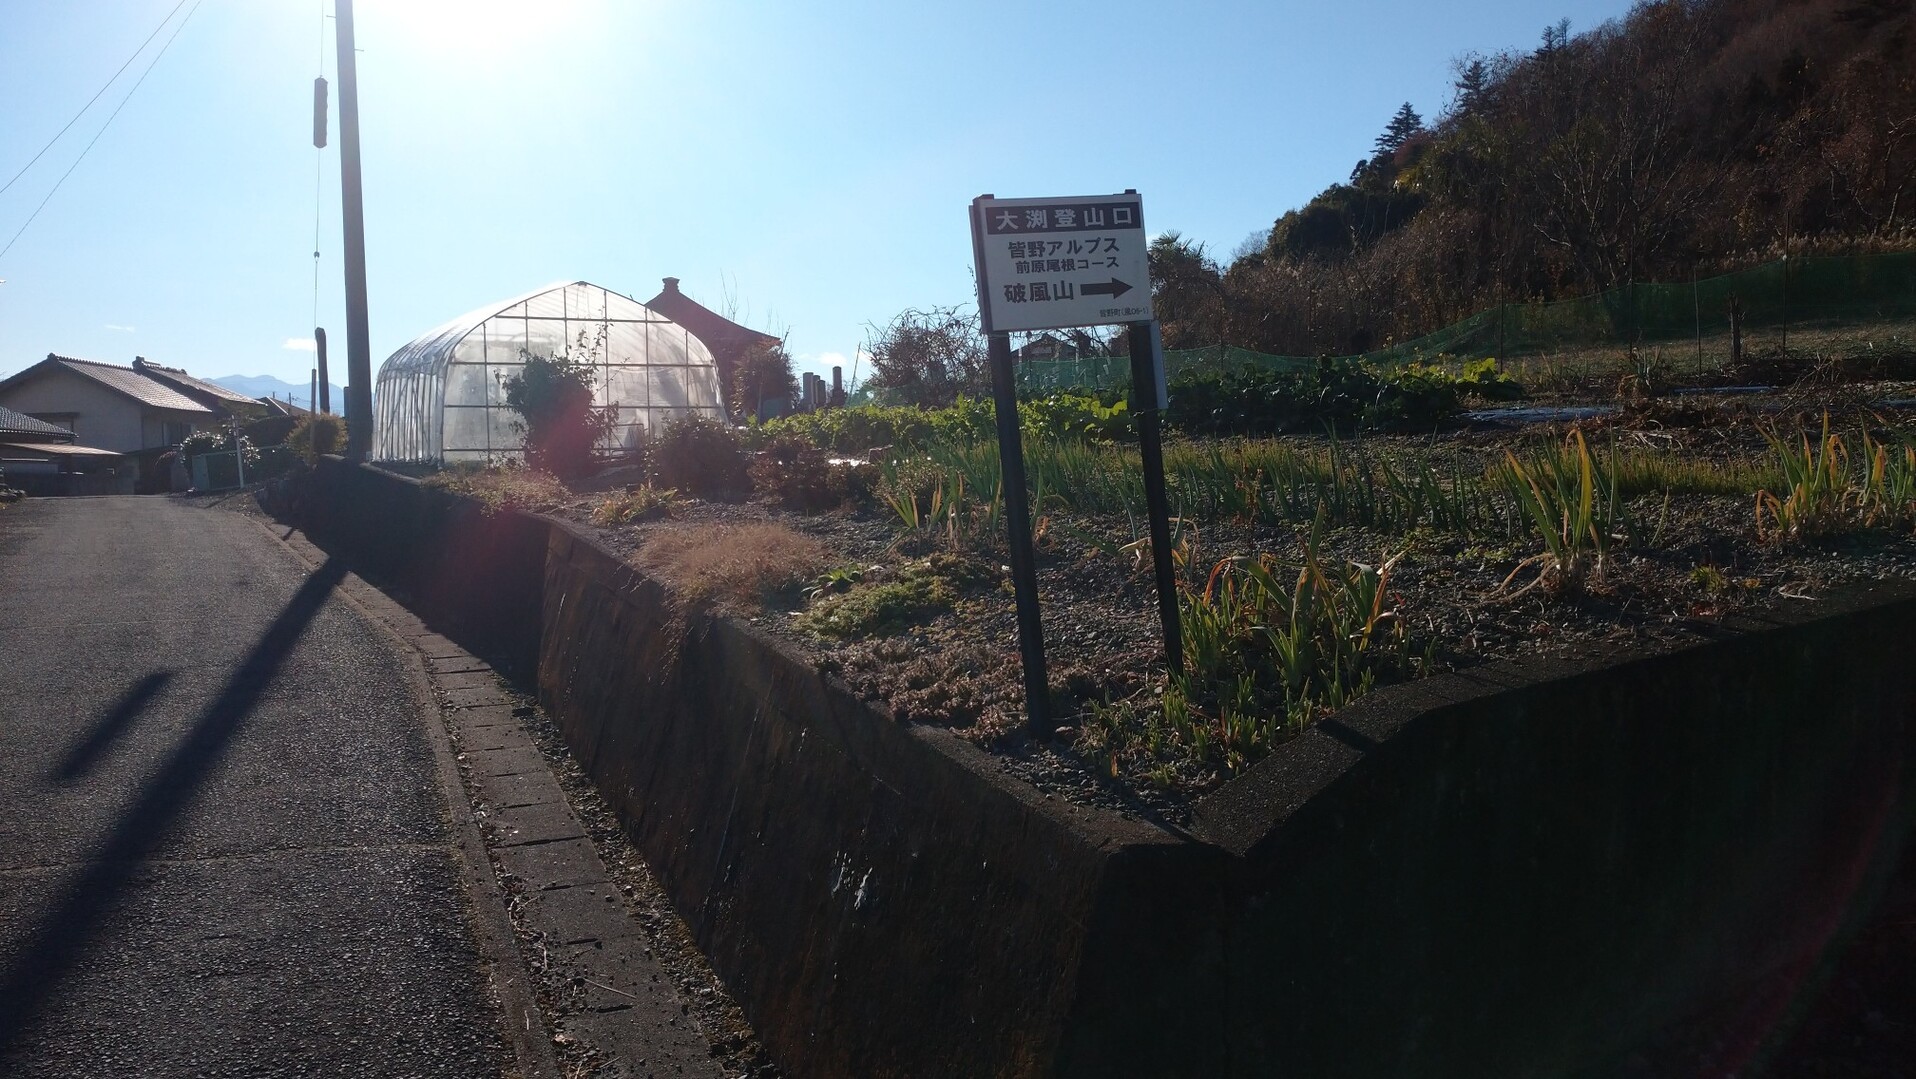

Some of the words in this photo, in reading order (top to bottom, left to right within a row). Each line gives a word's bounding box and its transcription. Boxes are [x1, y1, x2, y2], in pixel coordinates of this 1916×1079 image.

[1008, 237, 1120, 259] 皆野アルプス
[1016, 256, 1119, 274] 前原尾根コース
[1004, 280, 1074, 303] 破風山
